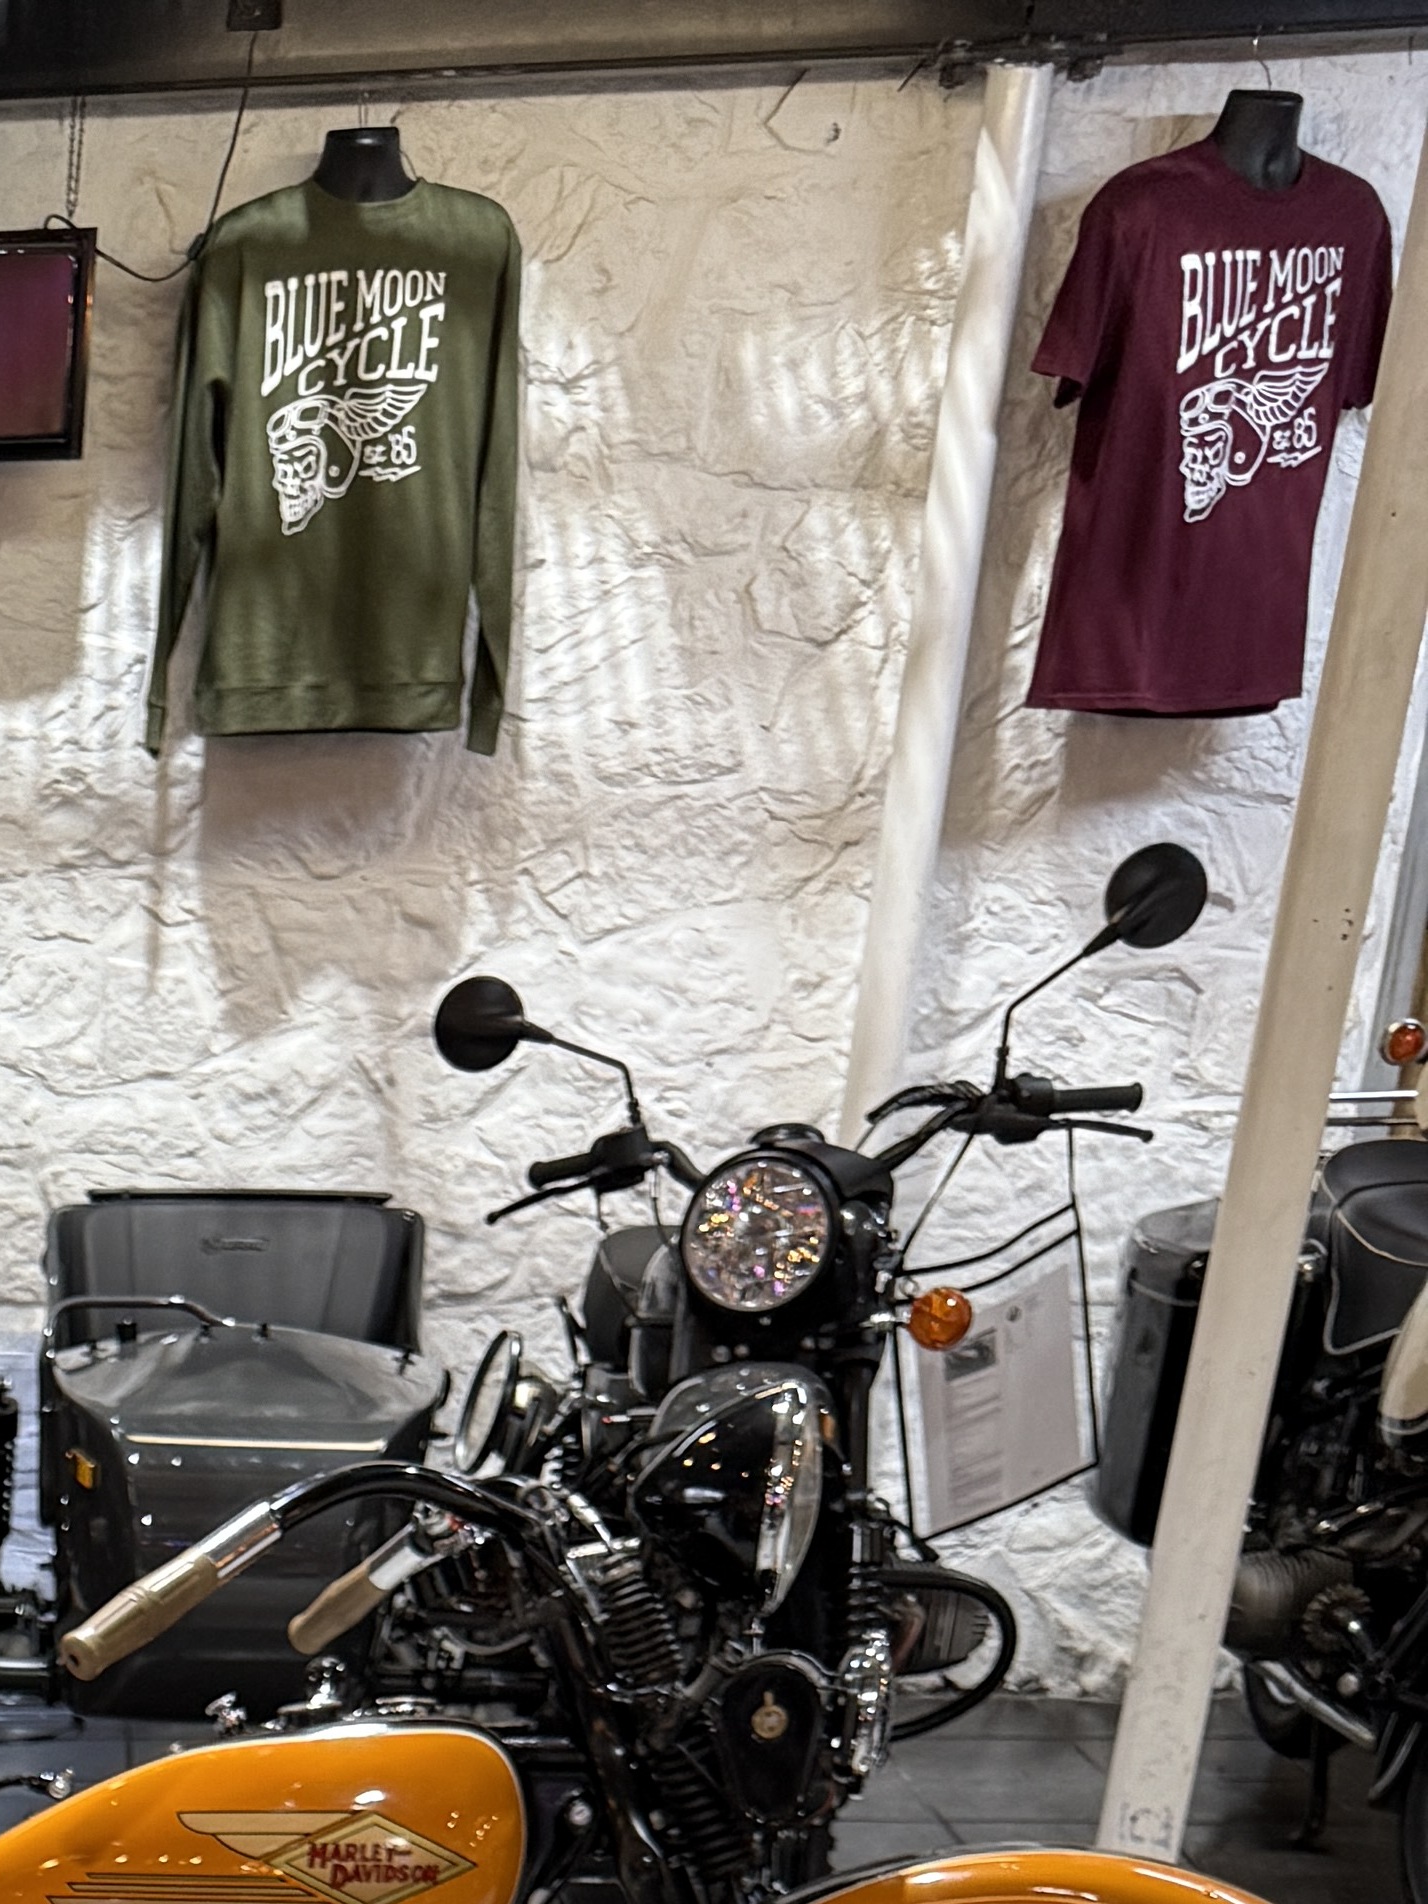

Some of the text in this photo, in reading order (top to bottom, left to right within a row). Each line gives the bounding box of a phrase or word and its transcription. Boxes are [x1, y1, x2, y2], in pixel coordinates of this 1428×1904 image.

[261, 269, 447, 397] BLUE MOON
[298, 303, 445, 396] CYCLE
[1176, 246, 1344, 373] BLUE MOON
[1214, 279, 1342, 379] CYCLE
[329, 1863, 440, 1890] DAVIDSON
